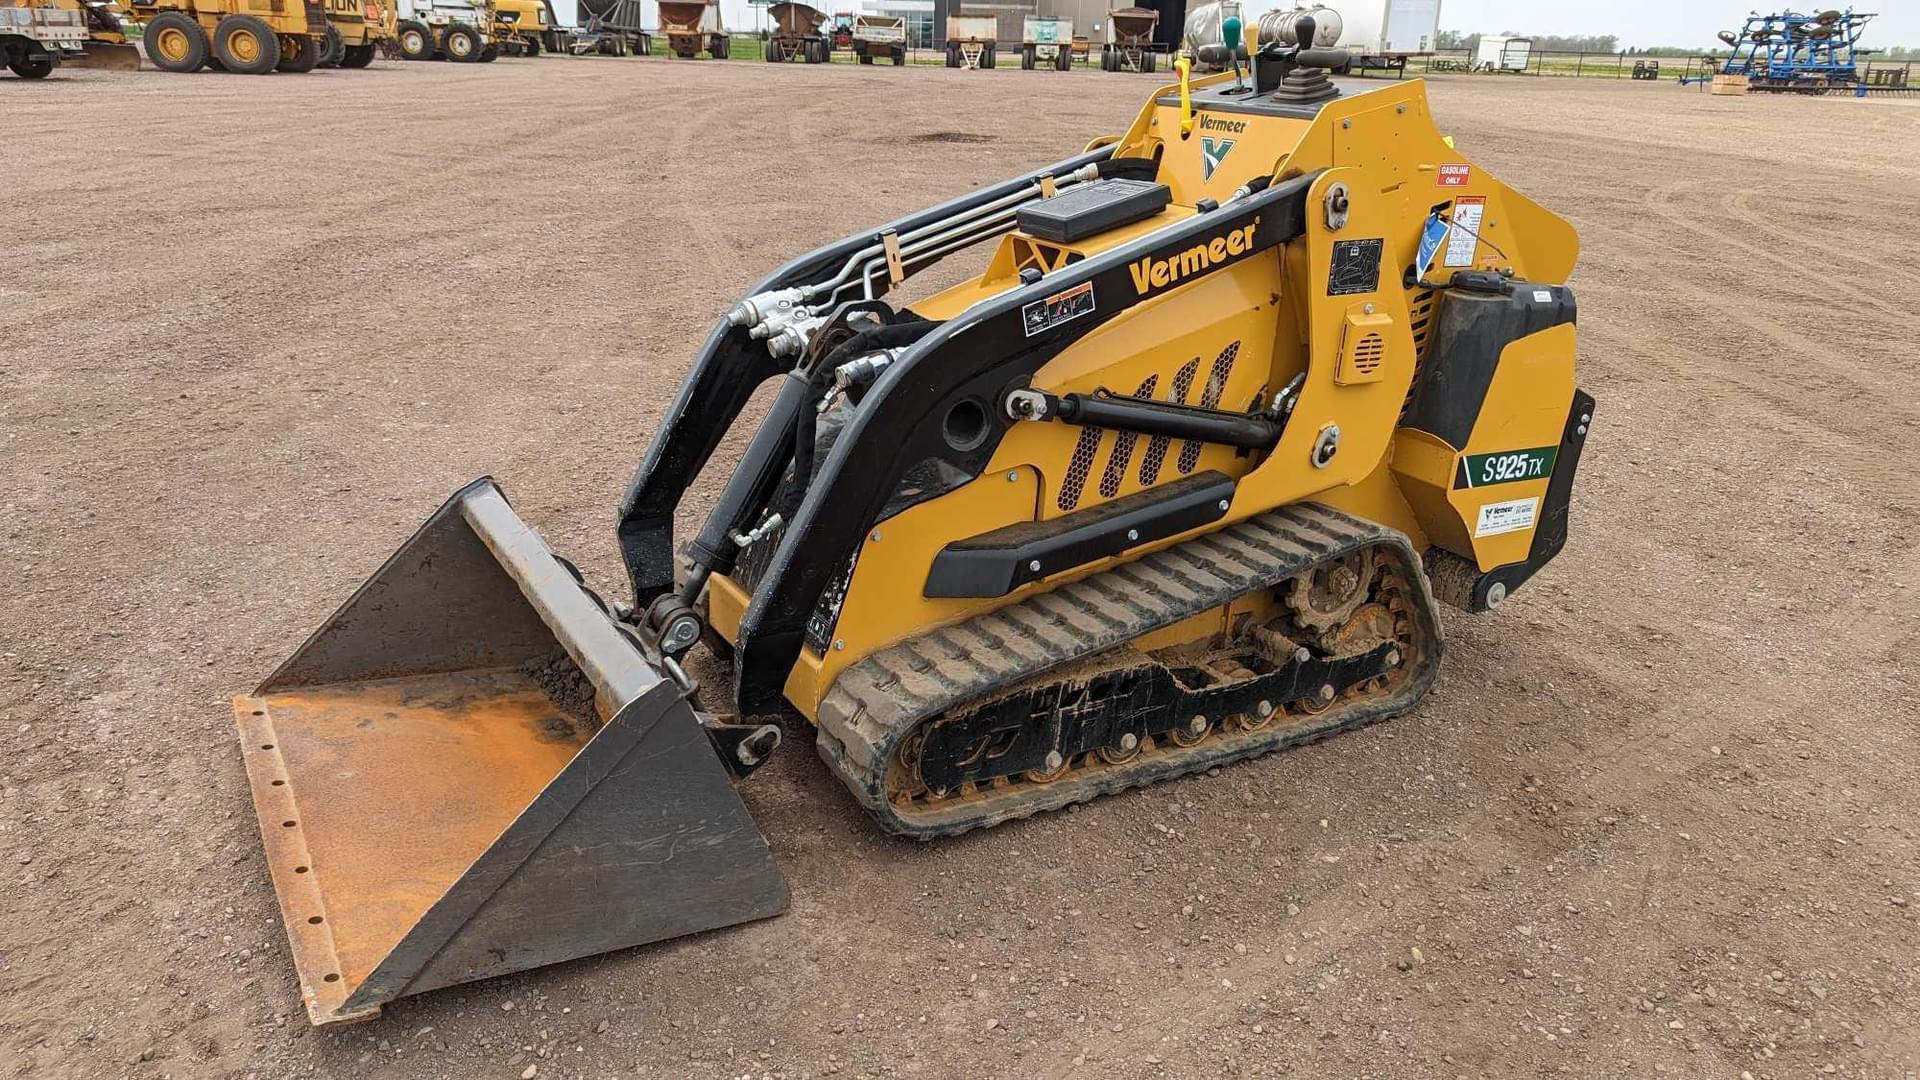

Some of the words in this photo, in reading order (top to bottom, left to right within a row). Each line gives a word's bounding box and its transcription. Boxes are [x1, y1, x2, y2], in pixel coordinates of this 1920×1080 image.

[1200, 114, 1246, 133] Vermeer
[1441, 166, 1469, 175] GASOLINE
[1445, 176, 1461, 185] ONLY
[1129, 223, 1256, 295] Vermeer
[1482, 454, 1544, 482] S925TX
